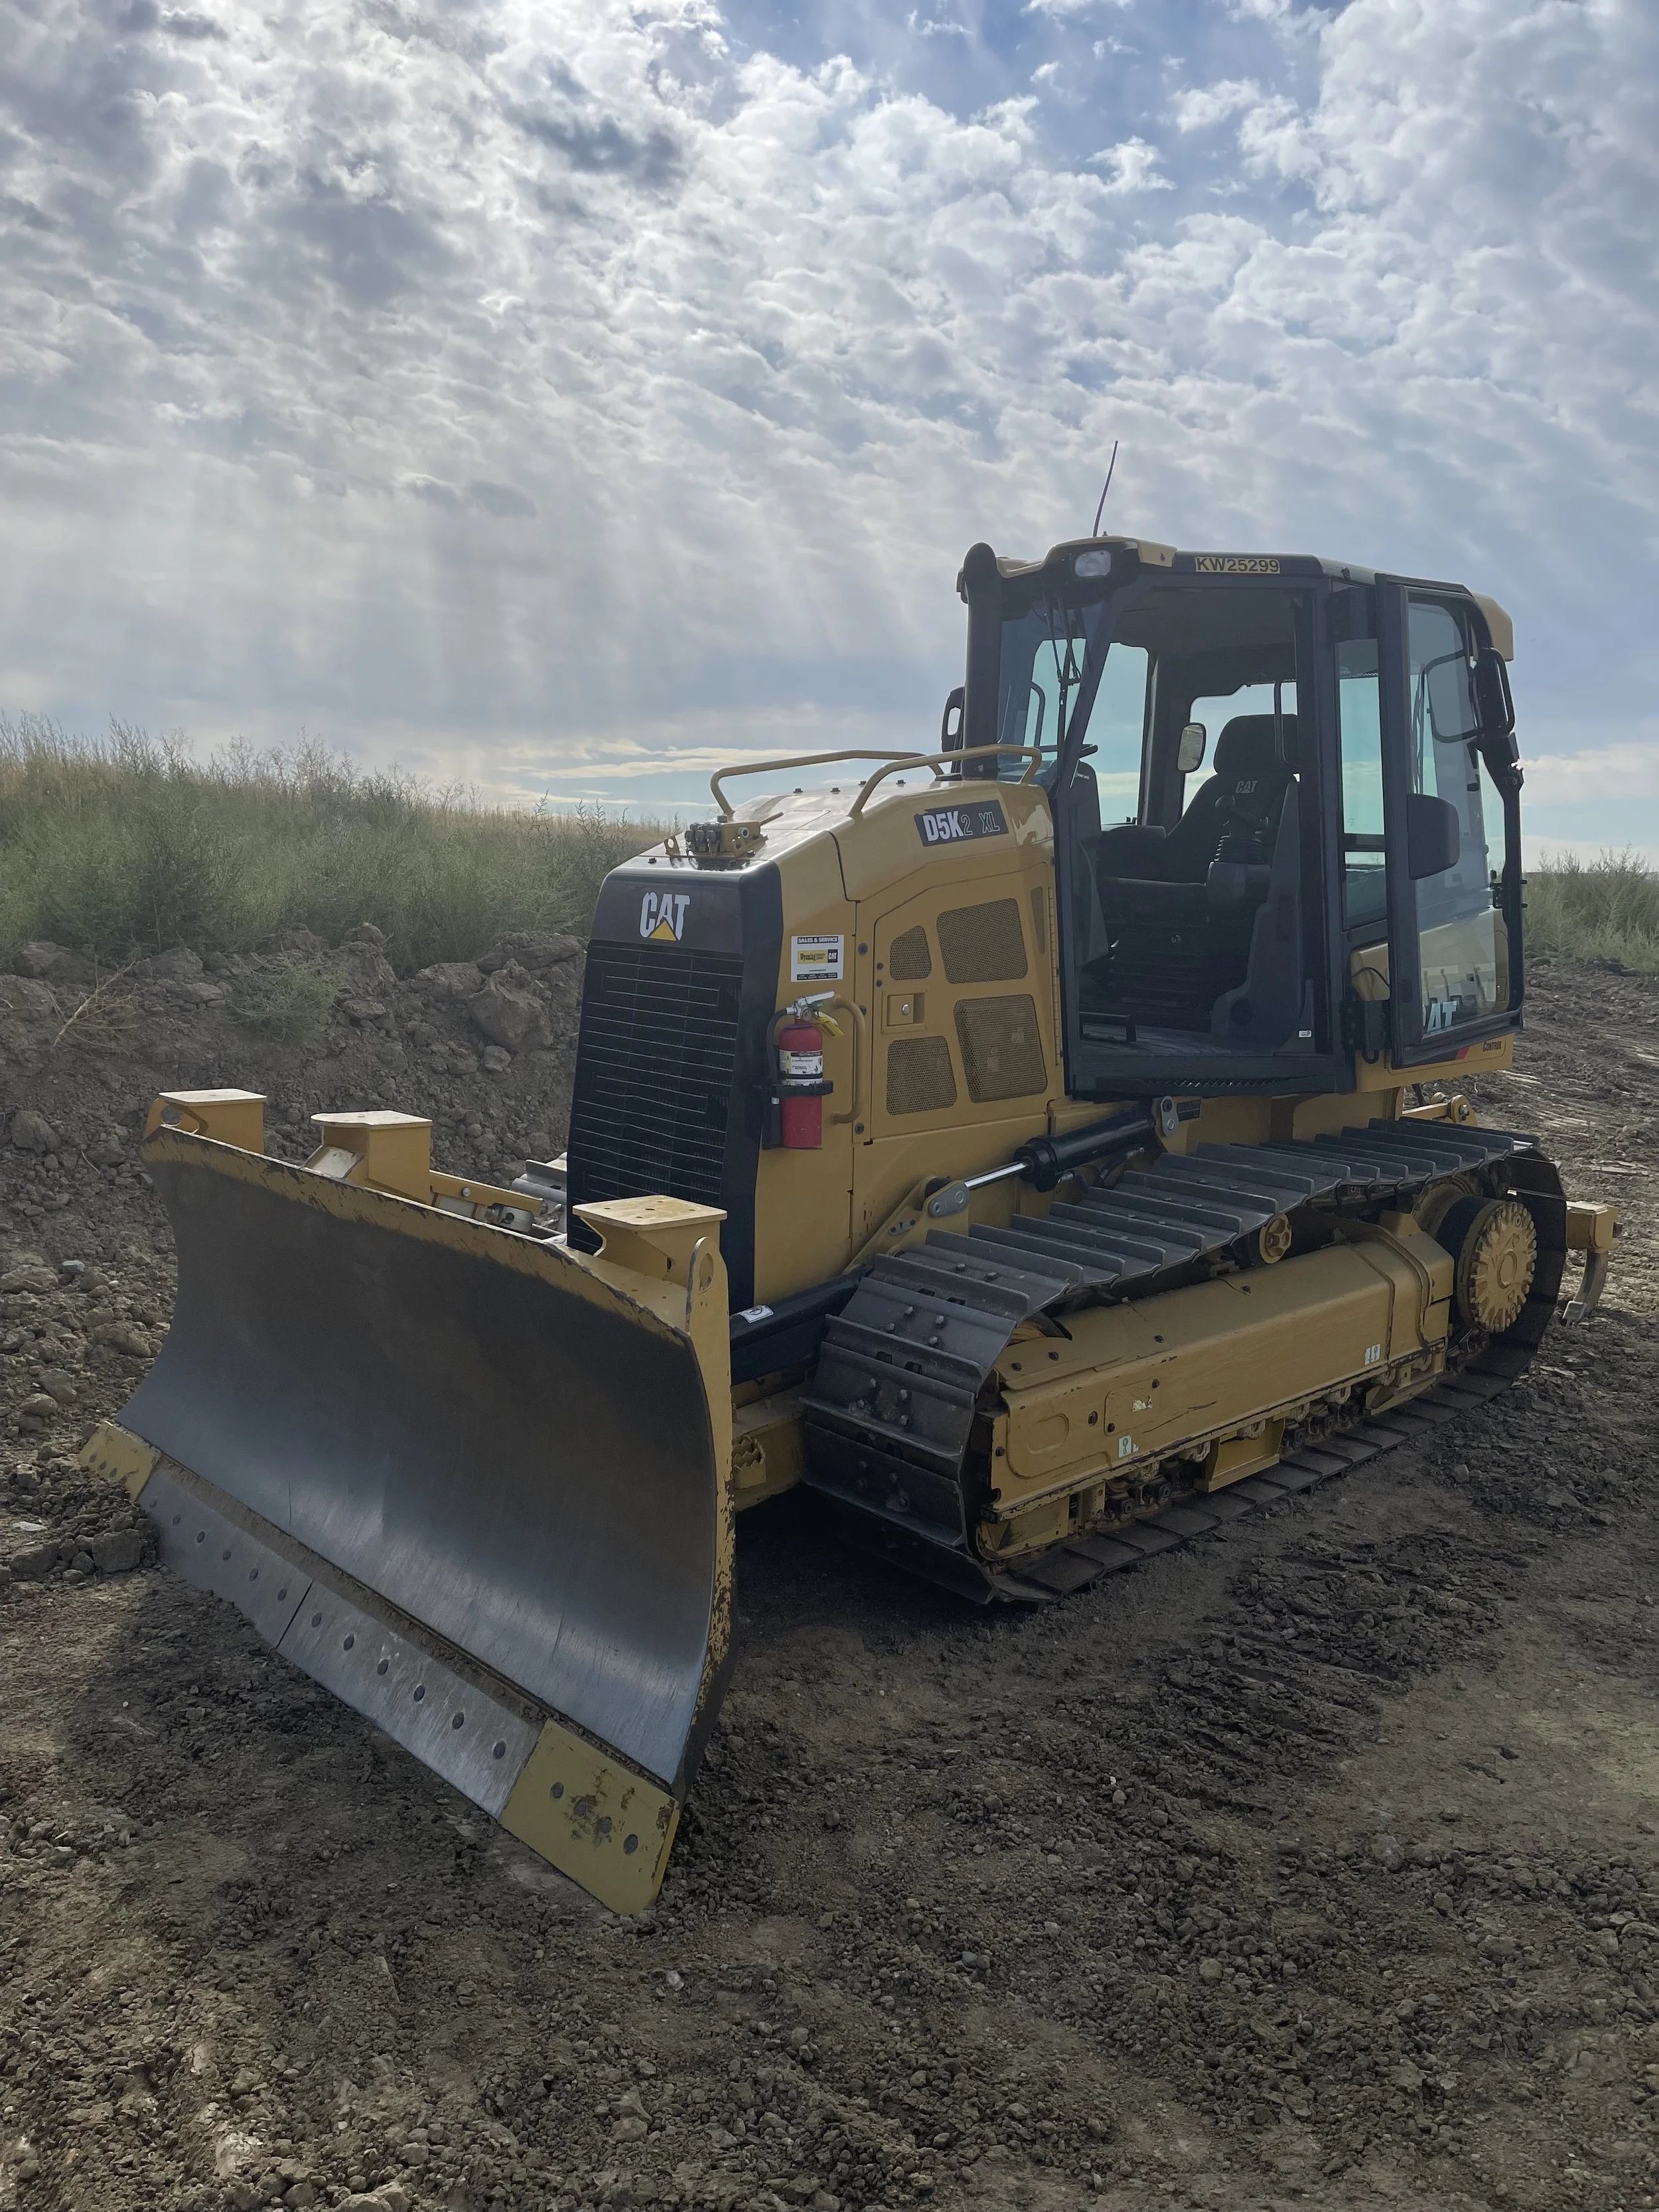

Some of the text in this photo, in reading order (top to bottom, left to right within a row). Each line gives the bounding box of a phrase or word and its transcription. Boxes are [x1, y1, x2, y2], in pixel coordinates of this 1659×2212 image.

[1196, 557, 1279, 573] KW25299
[1235, 780, 1258, 793] CAT
[922, 810, 1001, 842] D5K2 XL
[640, 892, 690, 941] CAT
[1423, 1000, 1457, 1032] AT
